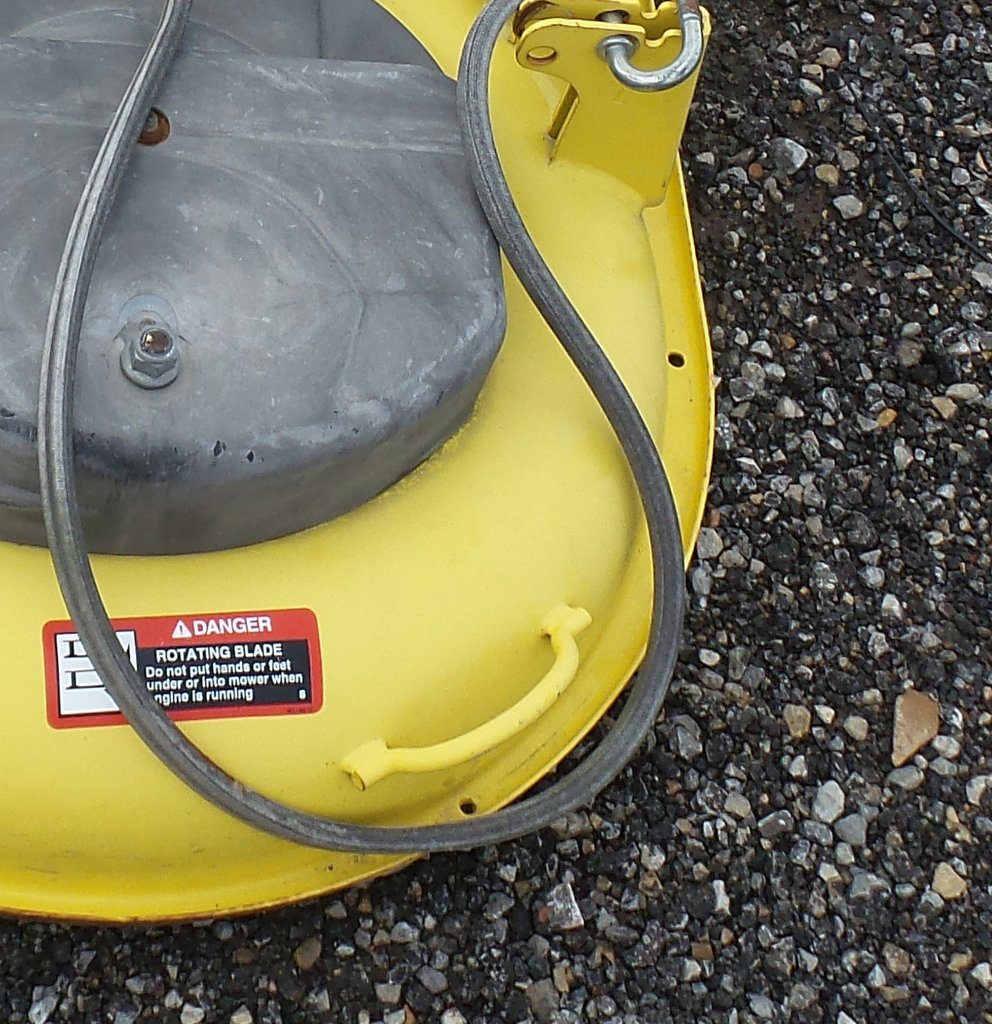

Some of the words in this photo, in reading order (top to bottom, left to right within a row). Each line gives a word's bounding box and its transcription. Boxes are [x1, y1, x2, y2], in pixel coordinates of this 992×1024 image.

[193, 616, 272, 636] DANGER
[156, 645, 231, 663] ROTATING
[234, 642, 283, 657] BLADE
[145, 665, 163, 678] Do
[165, 664, 187, 678] not
[189, 663, 211, 680] put
[213, 661, 251, 674] hands
[253, 662, 267, 672] or
[268, 659, 292, 672] feet
[146, 677, 182, 691] under
[185, 678, 200, 689] or
[201, 675, 226, 688] into
[228, 674, 269, 686] mower
[271, 672, 304, 685] when
[155, 691, 189, 706] ngine
[192, 689, 203, 701] is
[206, 687, 254, 703] running
